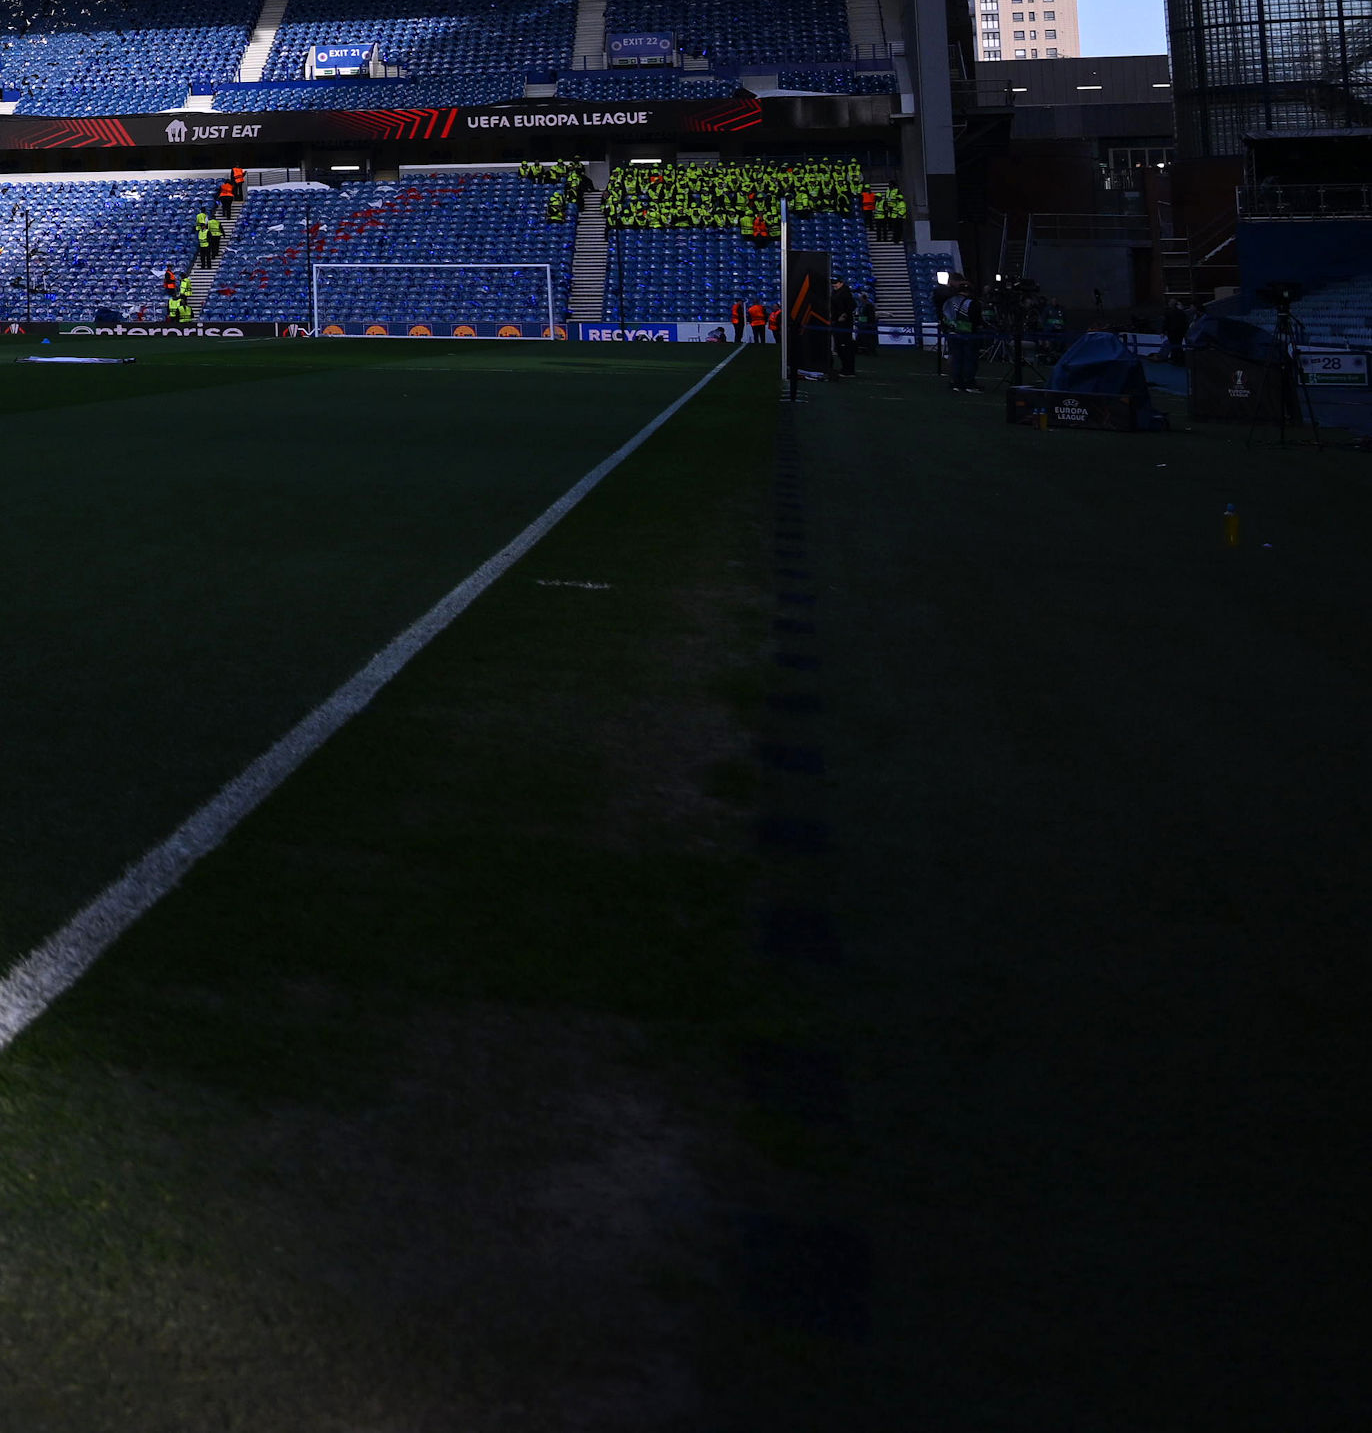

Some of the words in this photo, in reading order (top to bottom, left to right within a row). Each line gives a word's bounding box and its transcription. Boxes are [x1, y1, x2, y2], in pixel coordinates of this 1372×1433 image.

[623, 37, 644, 46] EXIT
[329, 49, 348, 57] EXIT
[468, 116, 510, 128] UEFA
[514, 114, 579, 127] EUROPA
[583, 112, 648, 125] LEAGUE
[191, 126, 229, 141] JUST
[232, 125, 262, 138] EAT
[1322, 357, 1342, 369] 28
[1055, 407, 1089, 415] EUROPA
